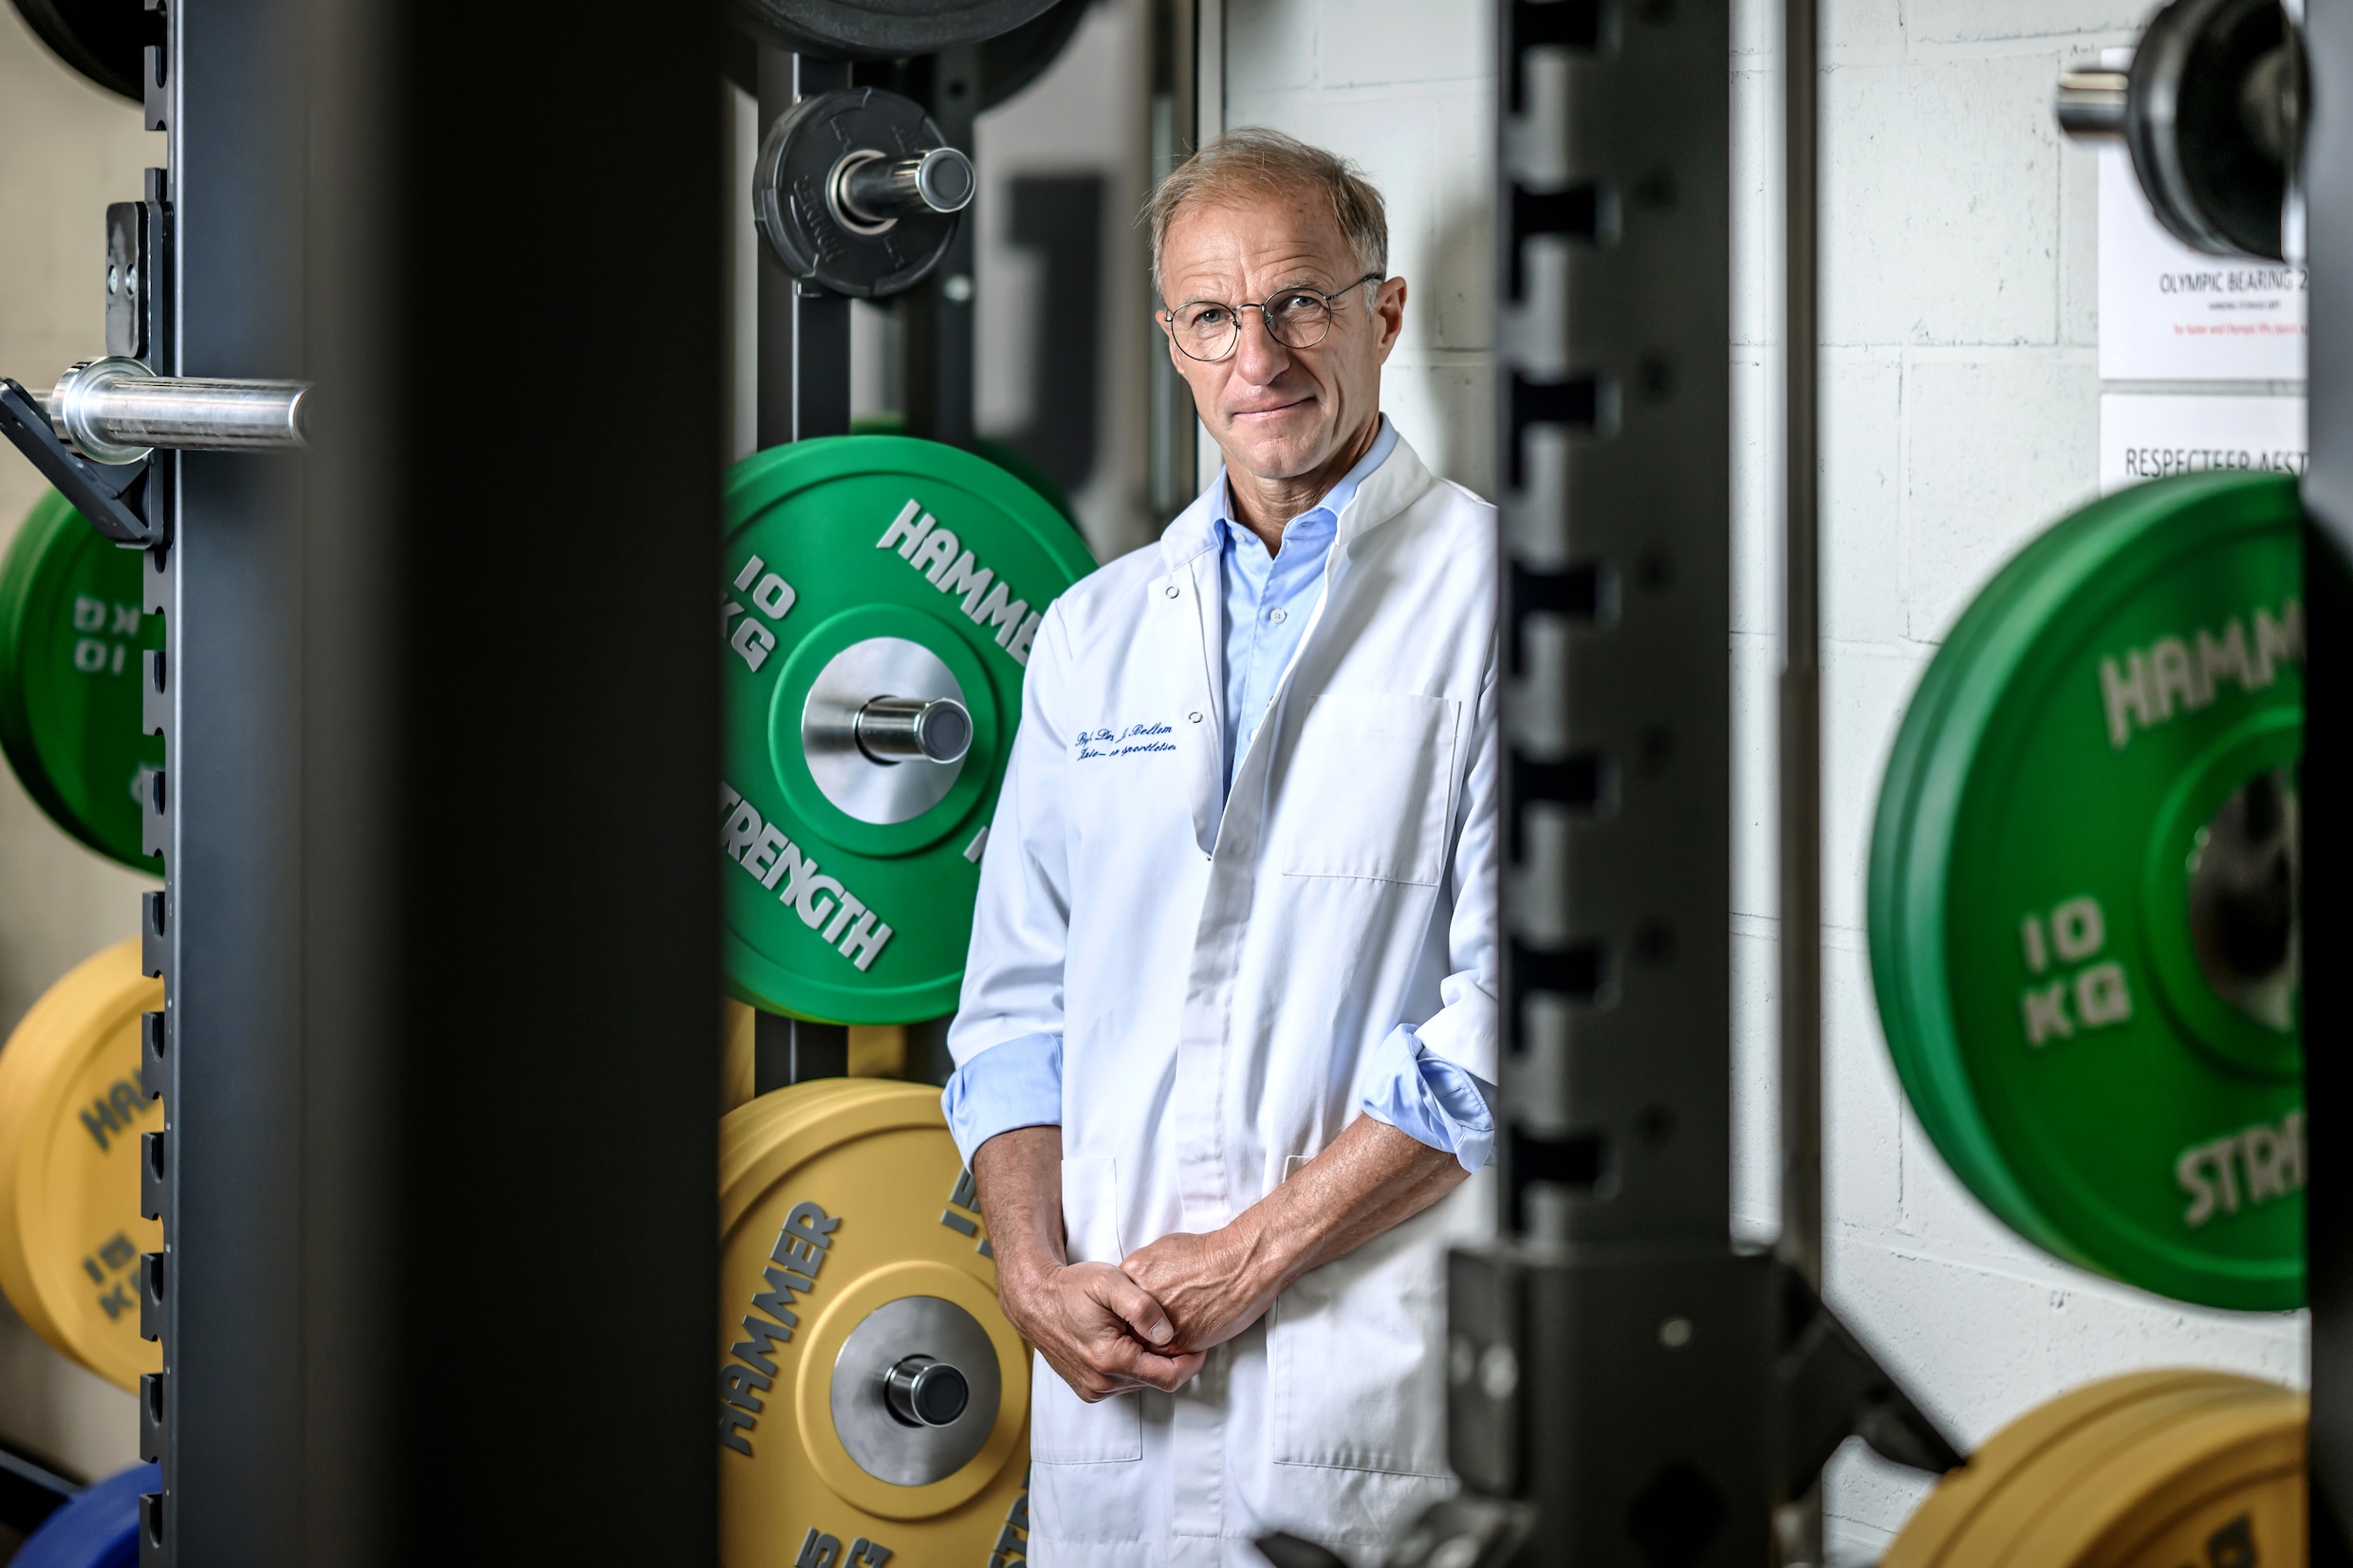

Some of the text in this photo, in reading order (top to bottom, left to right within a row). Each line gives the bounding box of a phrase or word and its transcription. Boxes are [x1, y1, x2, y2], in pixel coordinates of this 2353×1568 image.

[2159, 271, 2224, 295] OLYMPIC
[2227, 268, 2293, 293] BEARING
[733, 554, 796, 619] 10
[876, 498, 1043, 668] HAMME
[2023, 895, 2104, 972] 10
[2023, 961, 2133, 1048] KG
[718, 1201, 842, 1456] HAMMER
